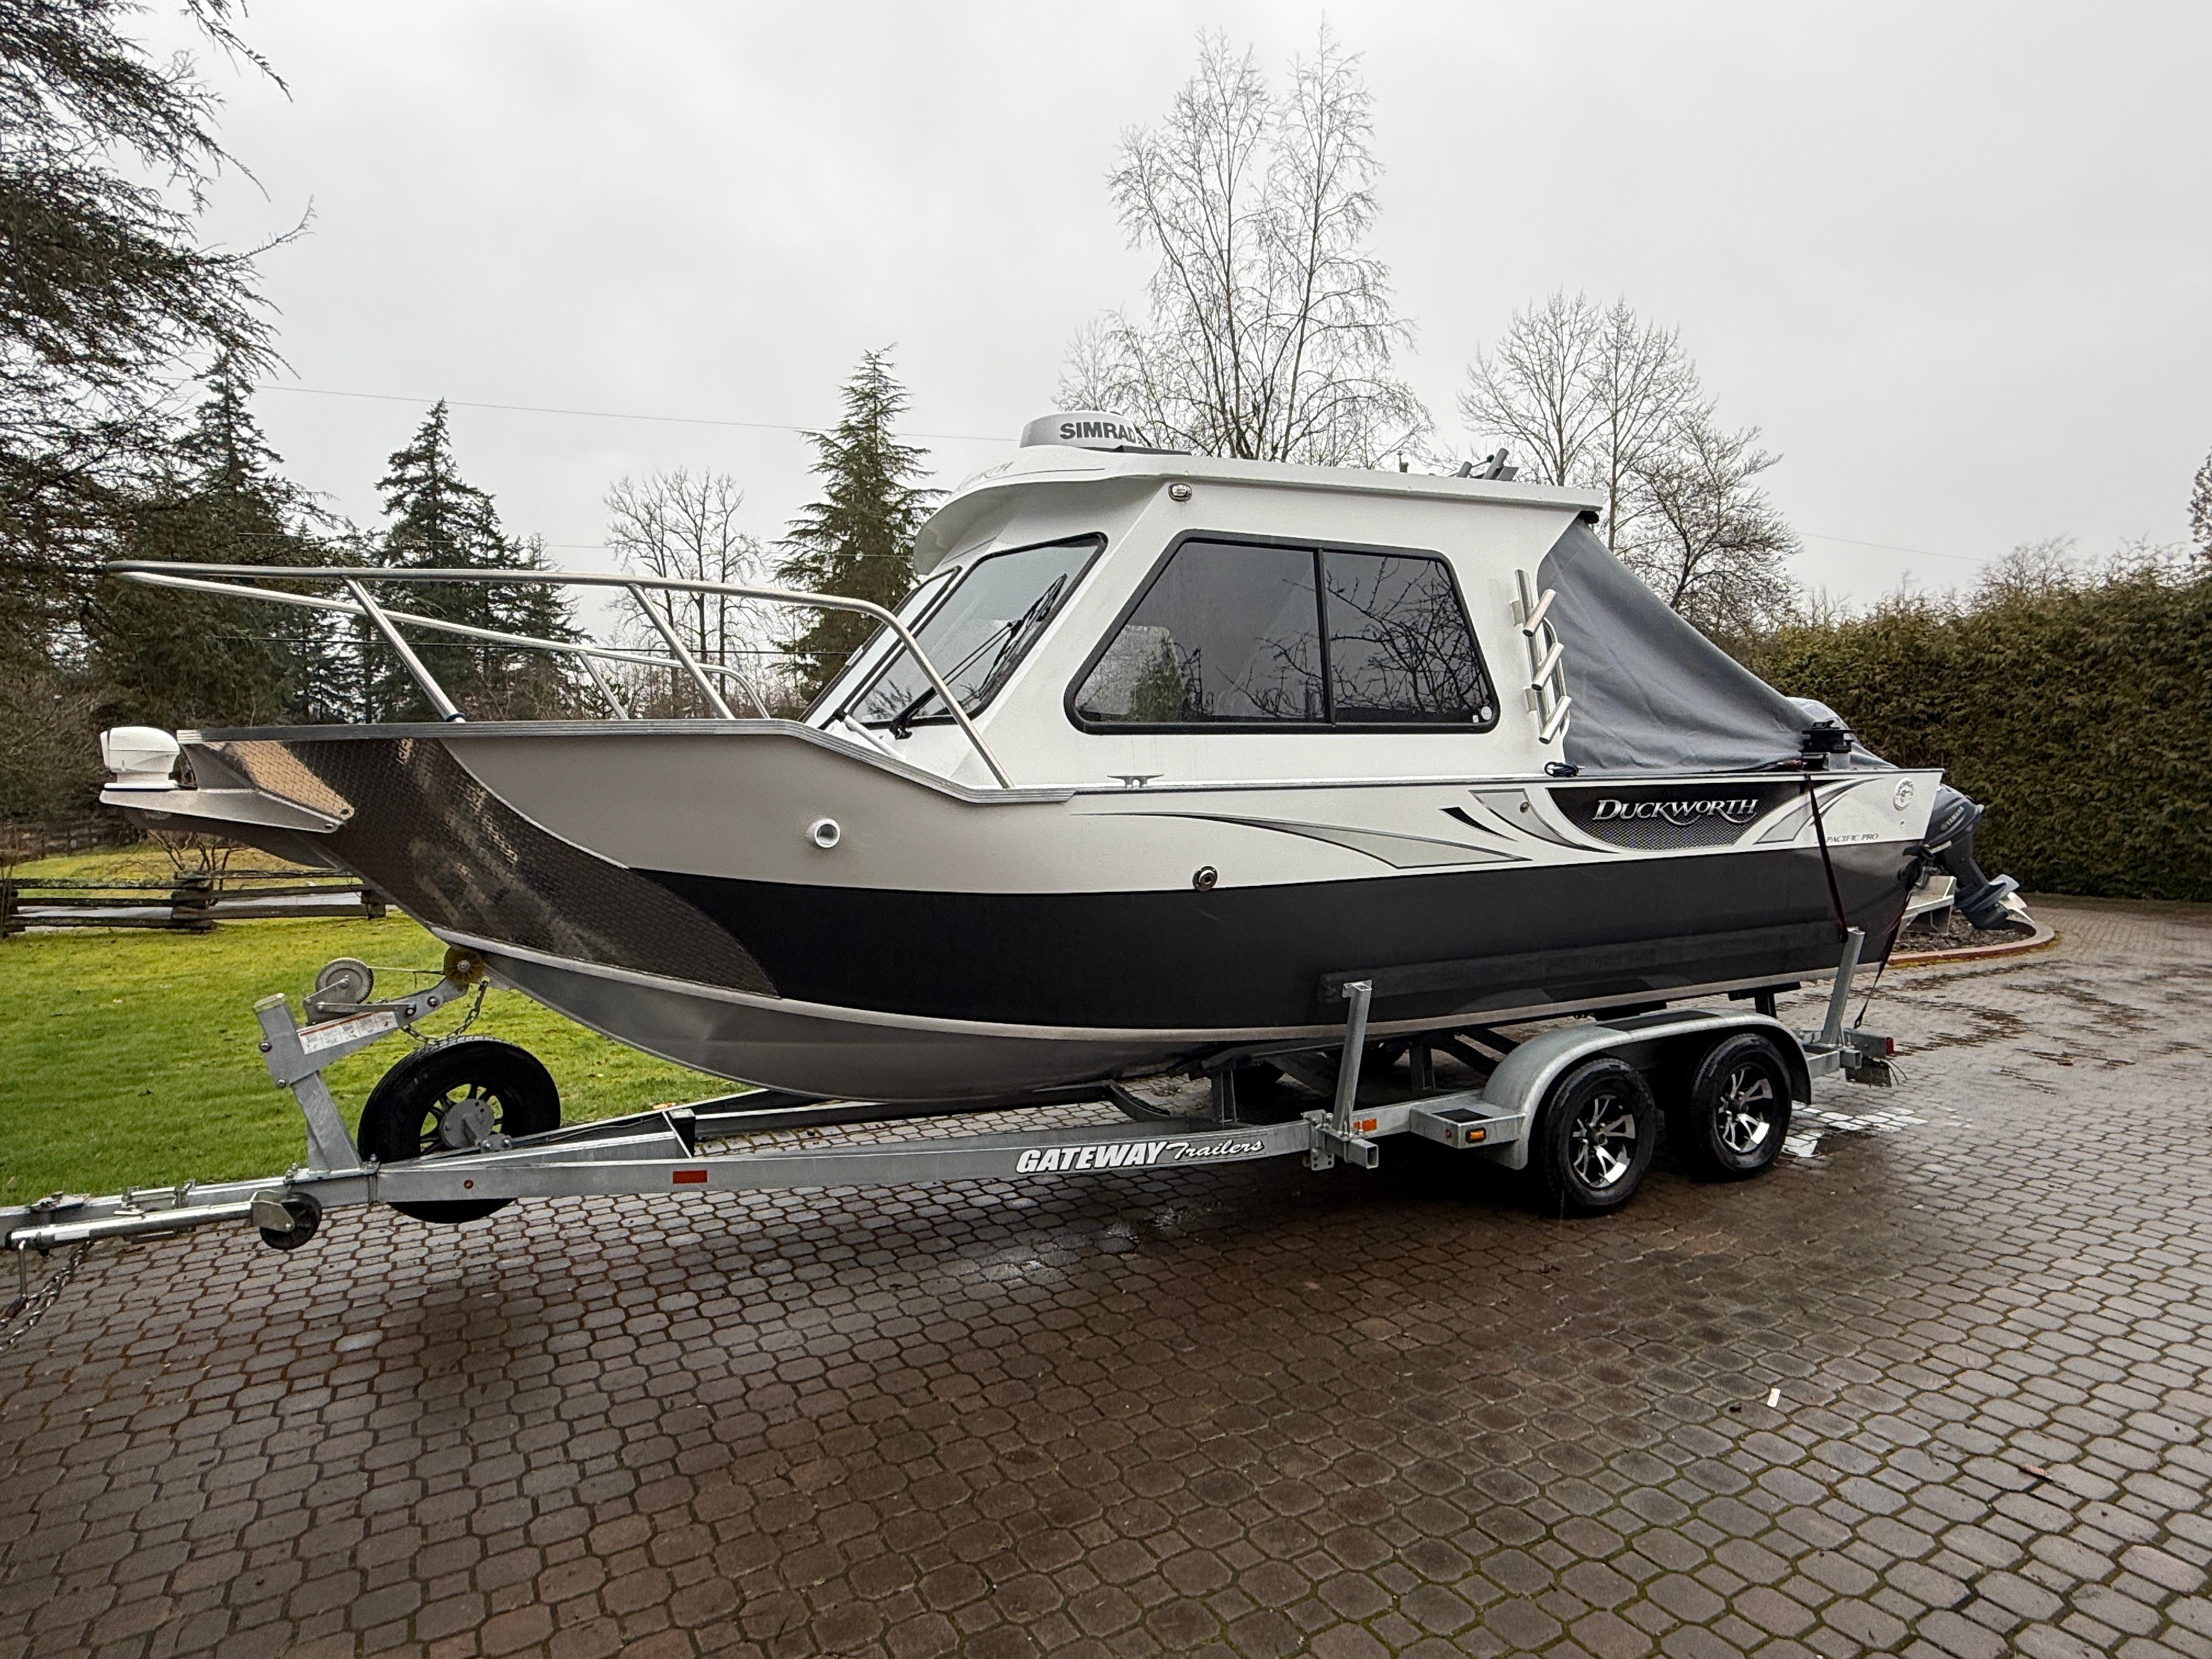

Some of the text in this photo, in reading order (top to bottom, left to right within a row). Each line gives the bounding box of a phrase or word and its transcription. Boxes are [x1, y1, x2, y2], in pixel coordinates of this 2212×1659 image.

[1059, 421, 1136, 443] SIMRAD
[1592, 799, 1759, 826] DUCKWORTH
[1826, 834, 1861, 843] PACIFIC
[1015, 1139, 1264, 1174] GATEWAY Trailers
